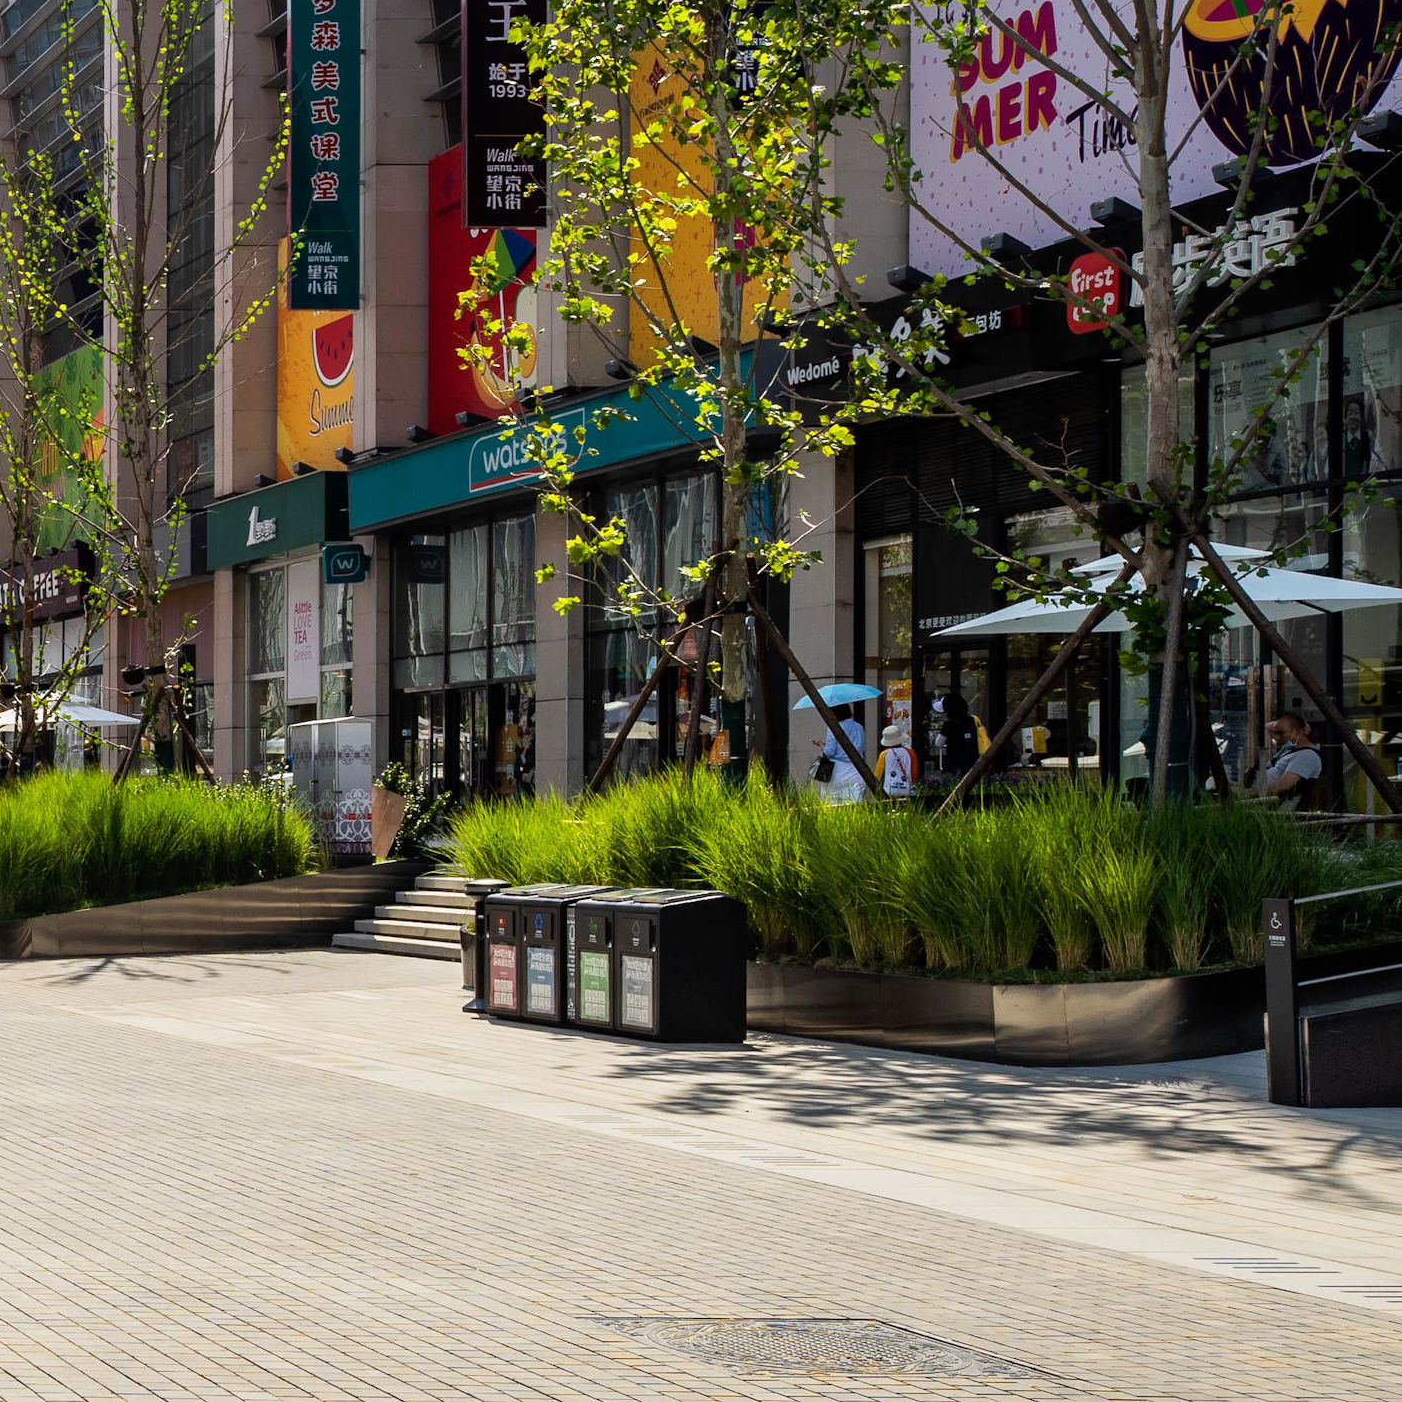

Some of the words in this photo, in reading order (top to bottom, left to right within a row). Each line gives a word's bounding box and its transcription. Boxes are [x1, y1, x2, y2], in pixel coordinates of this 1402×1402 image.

[488, 84, 527, 99] 1993
[949, 69, 1058, 164] MER
[486, 148, 516, 163] Walk
[486, 175, 522, 192] 望京
[486, 193, 522, 210] 小街
[308, 241, 333, 254] Walk
[307, 264, 338, 279] 望京
[1070, 266, 1115, 294] First
[307, 280, 338, 295] 小街
[963, 310, 1002, 338] 包坊
[787, 355, 840, 386] Wedomé
[293, 614, 312, 631] LOVE
[293, 631, 308, 645] TEA
